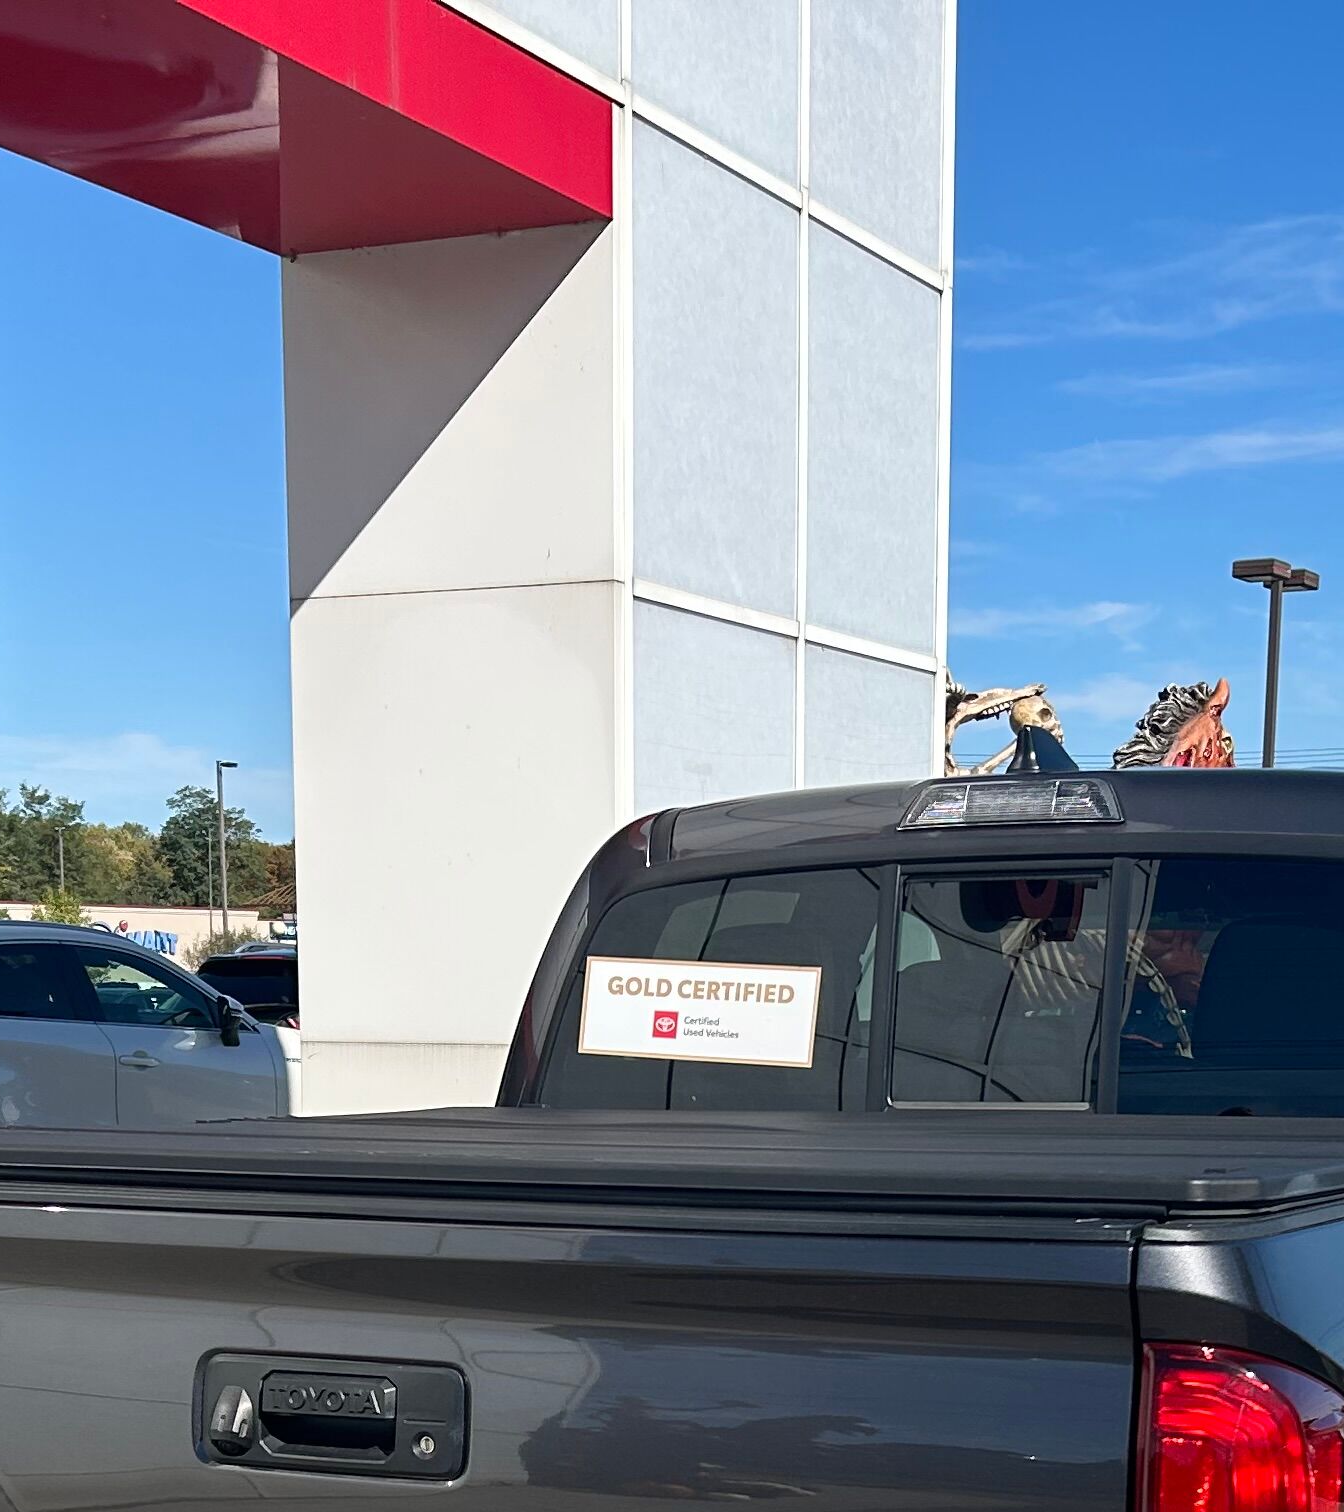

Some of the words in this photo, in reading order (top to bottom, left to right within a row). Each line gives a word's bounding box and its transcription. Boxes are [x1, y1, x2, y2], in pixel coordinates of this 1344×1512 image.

[607, 976, 673, 998] GOLD
[677, 979, 795, 1004] CERTIFIED
[683, 1016, 720, 1026] Certified
[683, 1028, 704, 1037] Used
[706, 1029, 739, 1039] Vehicles
[267, 1387, 382, 1415] TOYOTA
